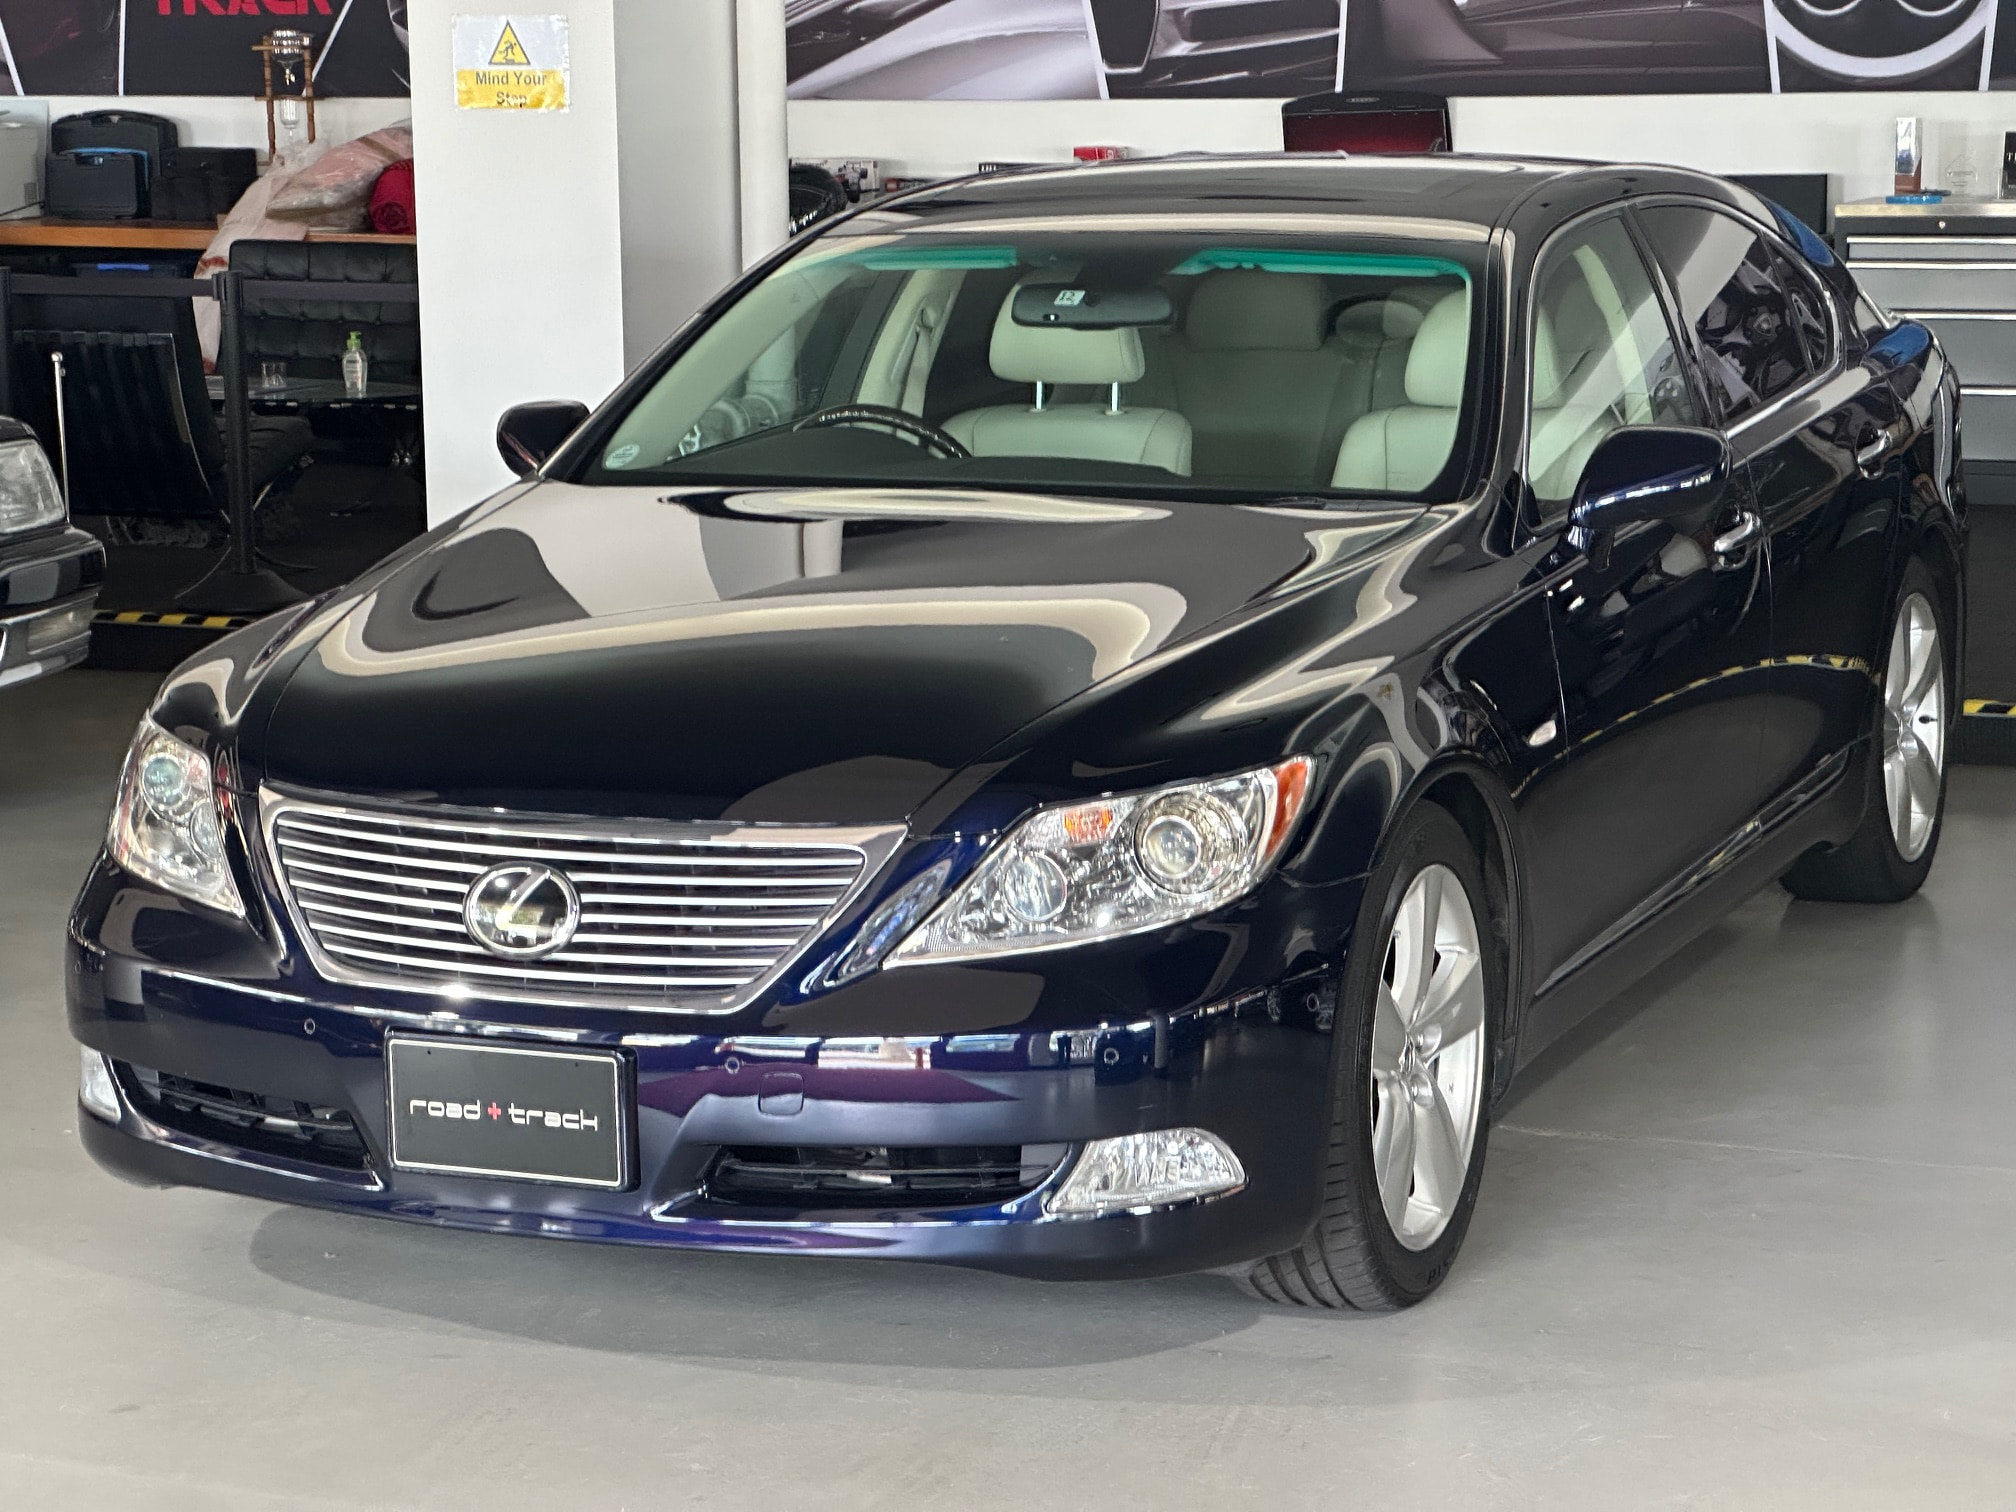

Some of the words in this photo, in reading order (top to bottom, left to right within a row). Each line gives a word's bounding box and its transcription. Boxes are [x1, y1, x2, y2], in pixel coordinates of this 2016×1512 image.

[476, 71, 509, 85] Mind
[513, 71, 547, 86] Your
[409, 1099, 481, 1120] road
[507, 1102, 599, 1132] track
